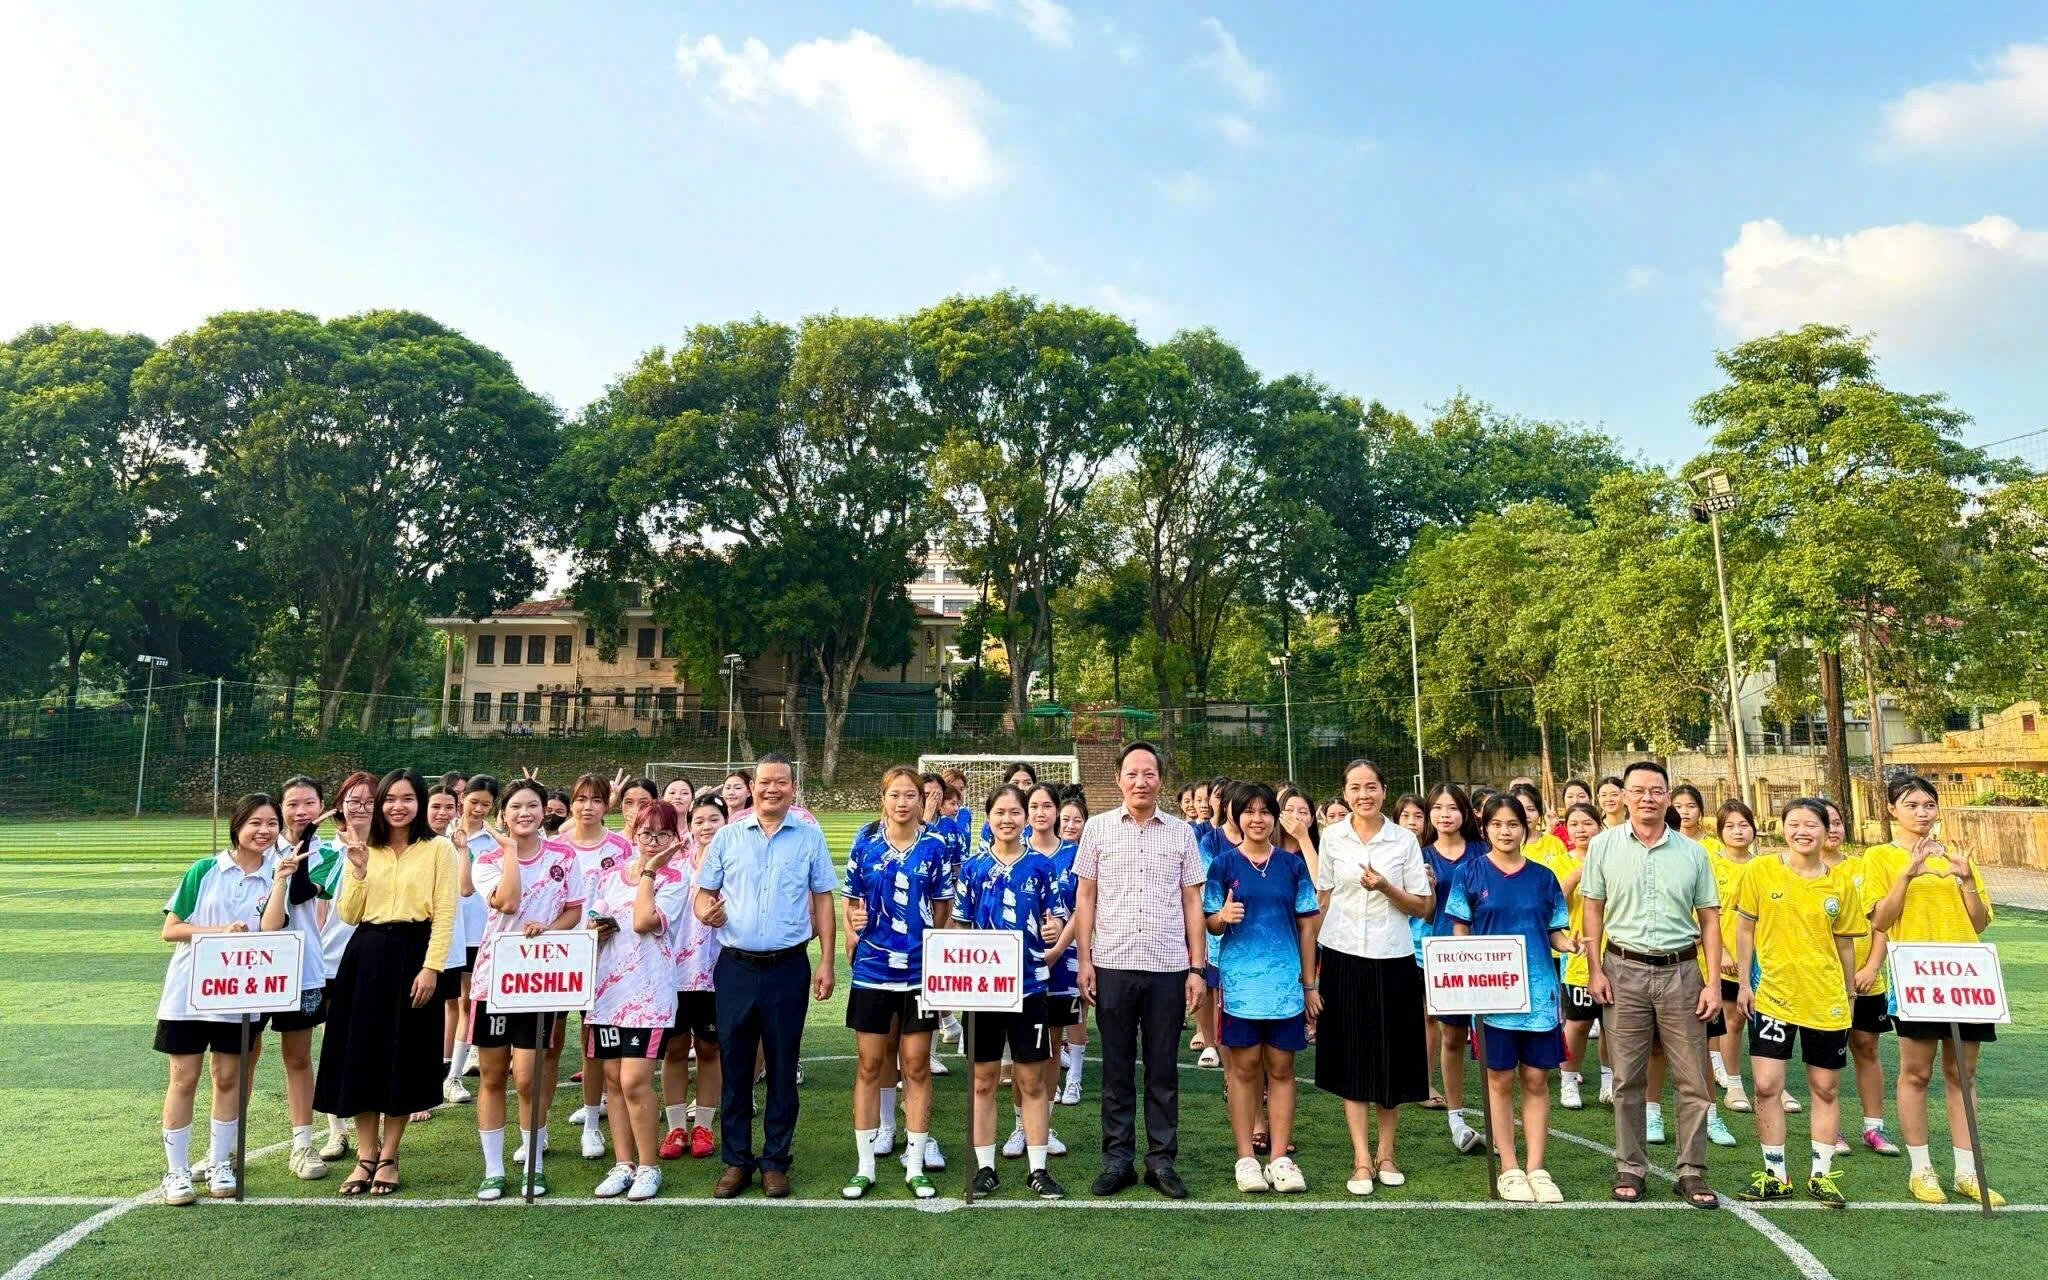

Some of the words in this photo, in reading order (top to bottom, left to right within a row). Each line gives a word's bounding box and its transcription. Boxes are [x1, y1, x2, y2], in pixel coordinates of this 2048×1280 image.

[220, 948, 274, 970] VIỆN
[519, 941, 570, 963] VIỆN
[943, 948, 1001, 964] KHOA
[1436, 951, 1482, 963] TRƯỜNG
[1485, 952, 1513, 962] THPT
[1913, 960, 1979, 977] KHOA
[201, 977, 239, 996] CNG
[245, 977, 258, 995] &
[264, 975, 288, 993] NT
[501, 971, 583, 994] CNSHLN
[927, 975, 973, 993] QLTNR
[978, 976, 989, 992] &
[994, 976, 1016, 992] MT
[1434, 972, 1464, 988] LÂM
[1468, 971, 1519, 989] NGHIỆP
[1573, 986, 1593, 1007] 05
[1905, 986, 1925, 1004] KT
[1932, 986, 1945, 1005] &
[1950, 987, 1996, 1006] QTKD
[489, 1015, 507, 1036] 18
[1034, 1023, 1043, 1049] 7
[1759, 1014, 1788, 1043] 25
[600, 1026, 621, 1048] 09
